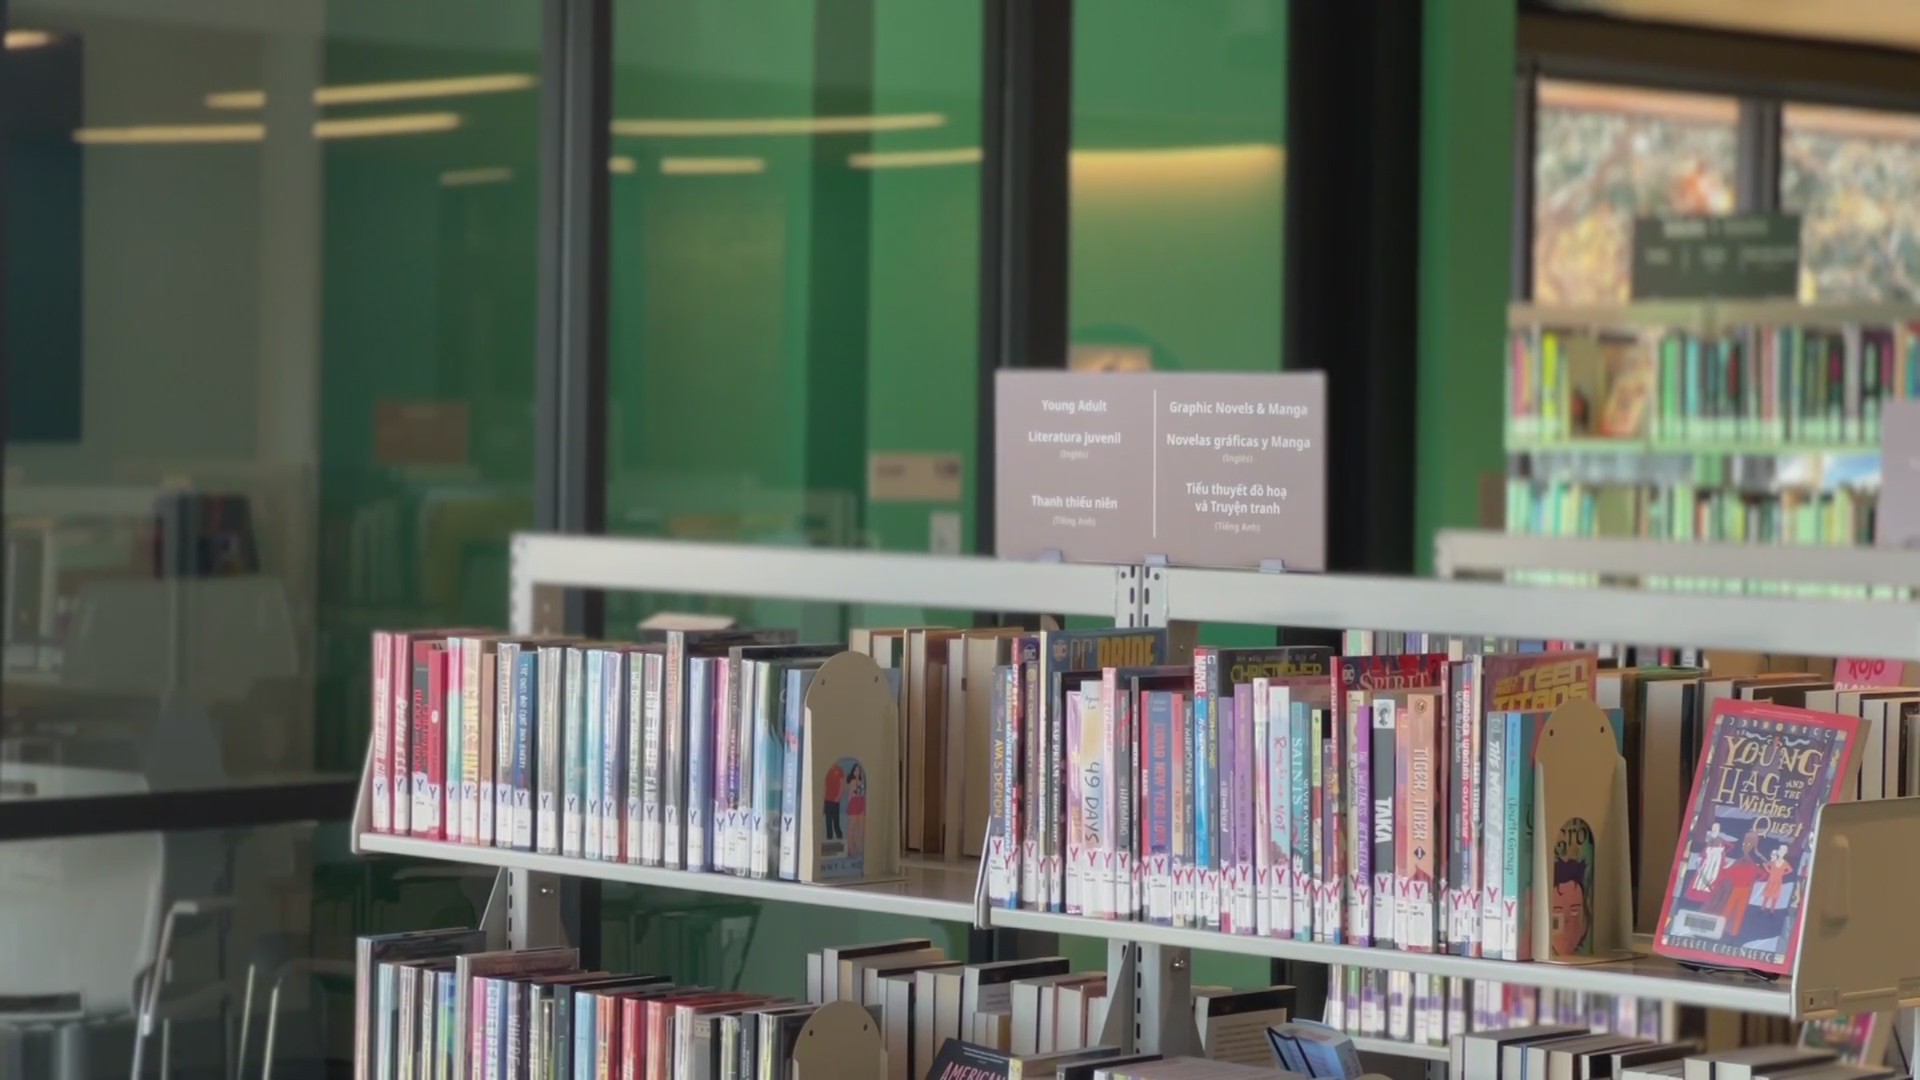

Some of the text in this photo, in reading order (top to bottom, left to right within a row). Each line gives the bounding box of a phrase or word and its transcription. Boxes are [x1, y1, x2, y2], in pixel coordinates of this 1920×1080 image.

[1042, 399, 1107, 414] Young Adult
[1169, 401, 1308, 418] Graphic Novels & Manga
[1028, 431, 1121, 446] Literatura juvenil
[1166, 433, 1310, 451] Novelas gráficas y Manga
[1031, 495, 1064, 508] Thanh
[1095, 497, 1118, 510] niên
[1195, 501, 1208, 513] và
[1250, 503, 1280, 514] tranh
[1194, 655, 1206, 694] MARVEL
[1154, 722, 1166, 758] LUNAR
[1154, 762, 1166, 787] NEW
[1292, 737, 1302, 805] SAINTS
[1723, 735, 1825, 785] YOUNG
[993, 739, 1004, 819] AVA'S DEMON
[1712, 766, 1781, 805] HAG
[1784, 790, 1801, 799] THE
[1085, 762, 1100, 842] 49 DAYS
[1154, 790, 1166, 818] YEAR
[1375, 797, 1392, 843] TAKA
[1412, 798, 1428, 841] TIGER
[1752, 815, 1805, 839] Quest
[1504, 837, 1516, 875] Group
